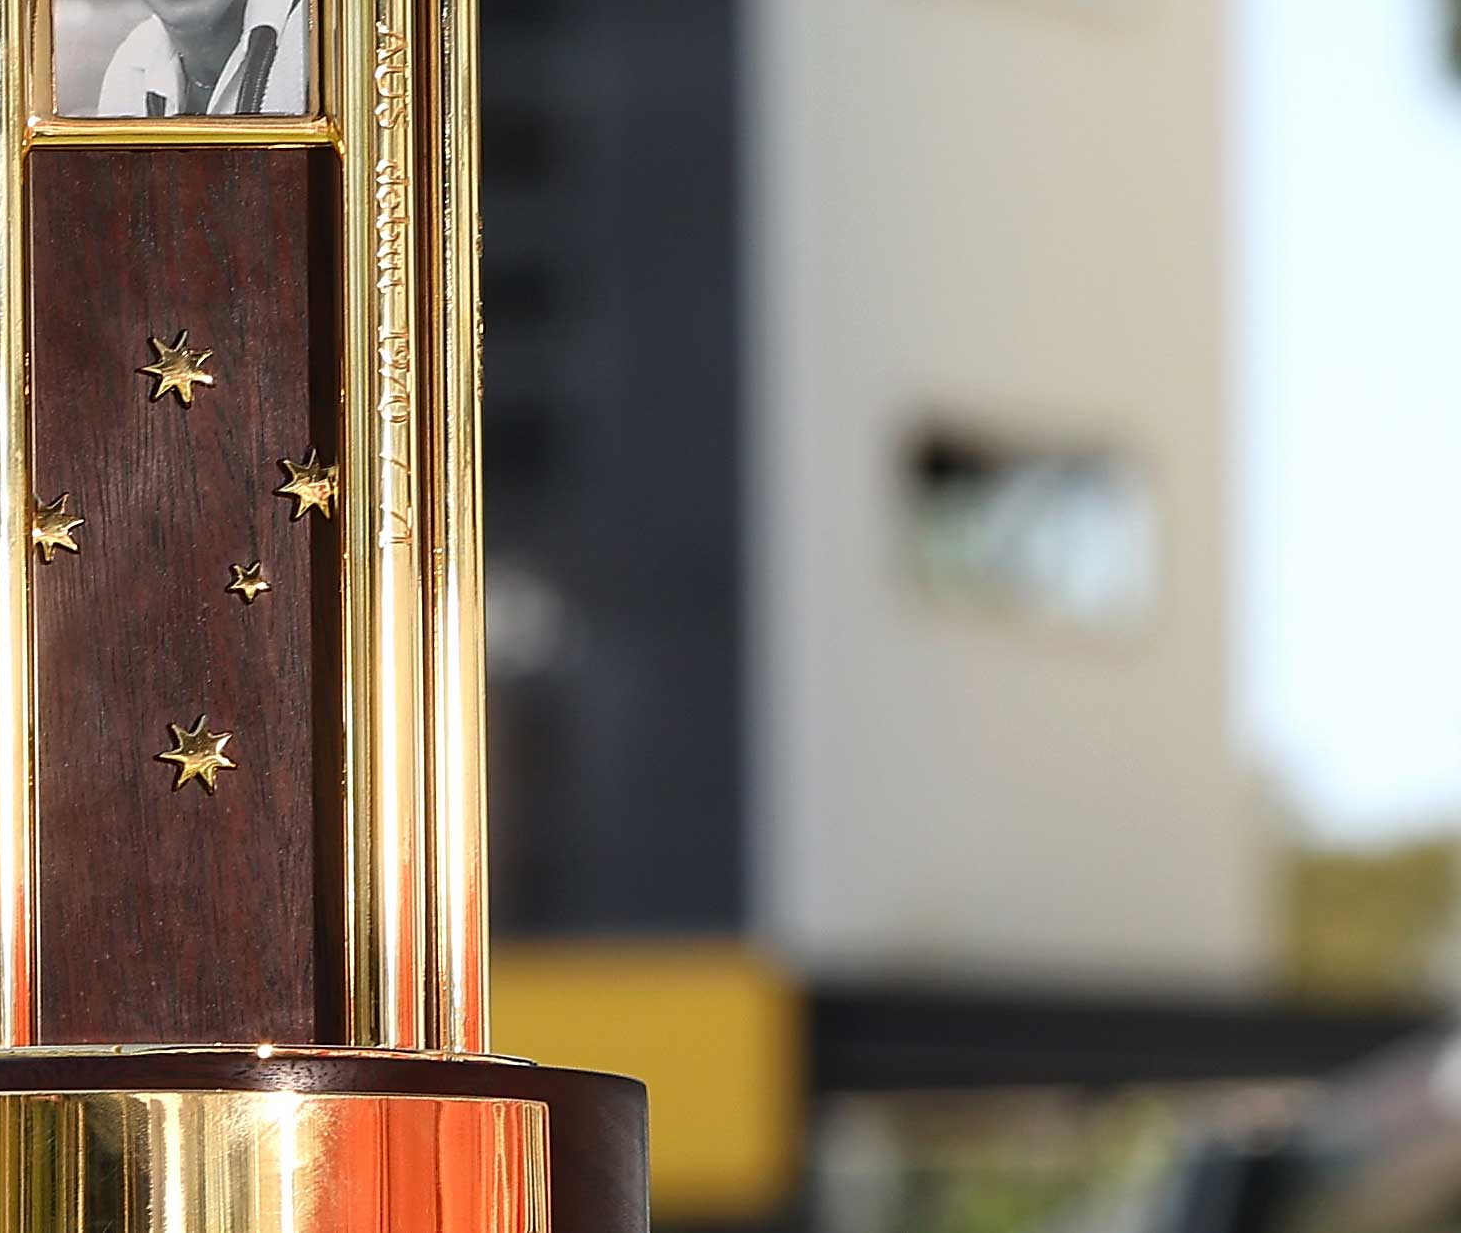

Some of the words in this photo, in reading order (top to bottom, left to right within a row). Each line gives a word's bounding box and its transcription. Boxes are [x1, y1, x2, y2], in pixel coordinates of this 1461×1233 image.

[374, 20, 411, 131] AUS
[374, 158, 410, 295] debut
[376, 324, 411, 425] 1970
[378, 504, 413, 551] 71
